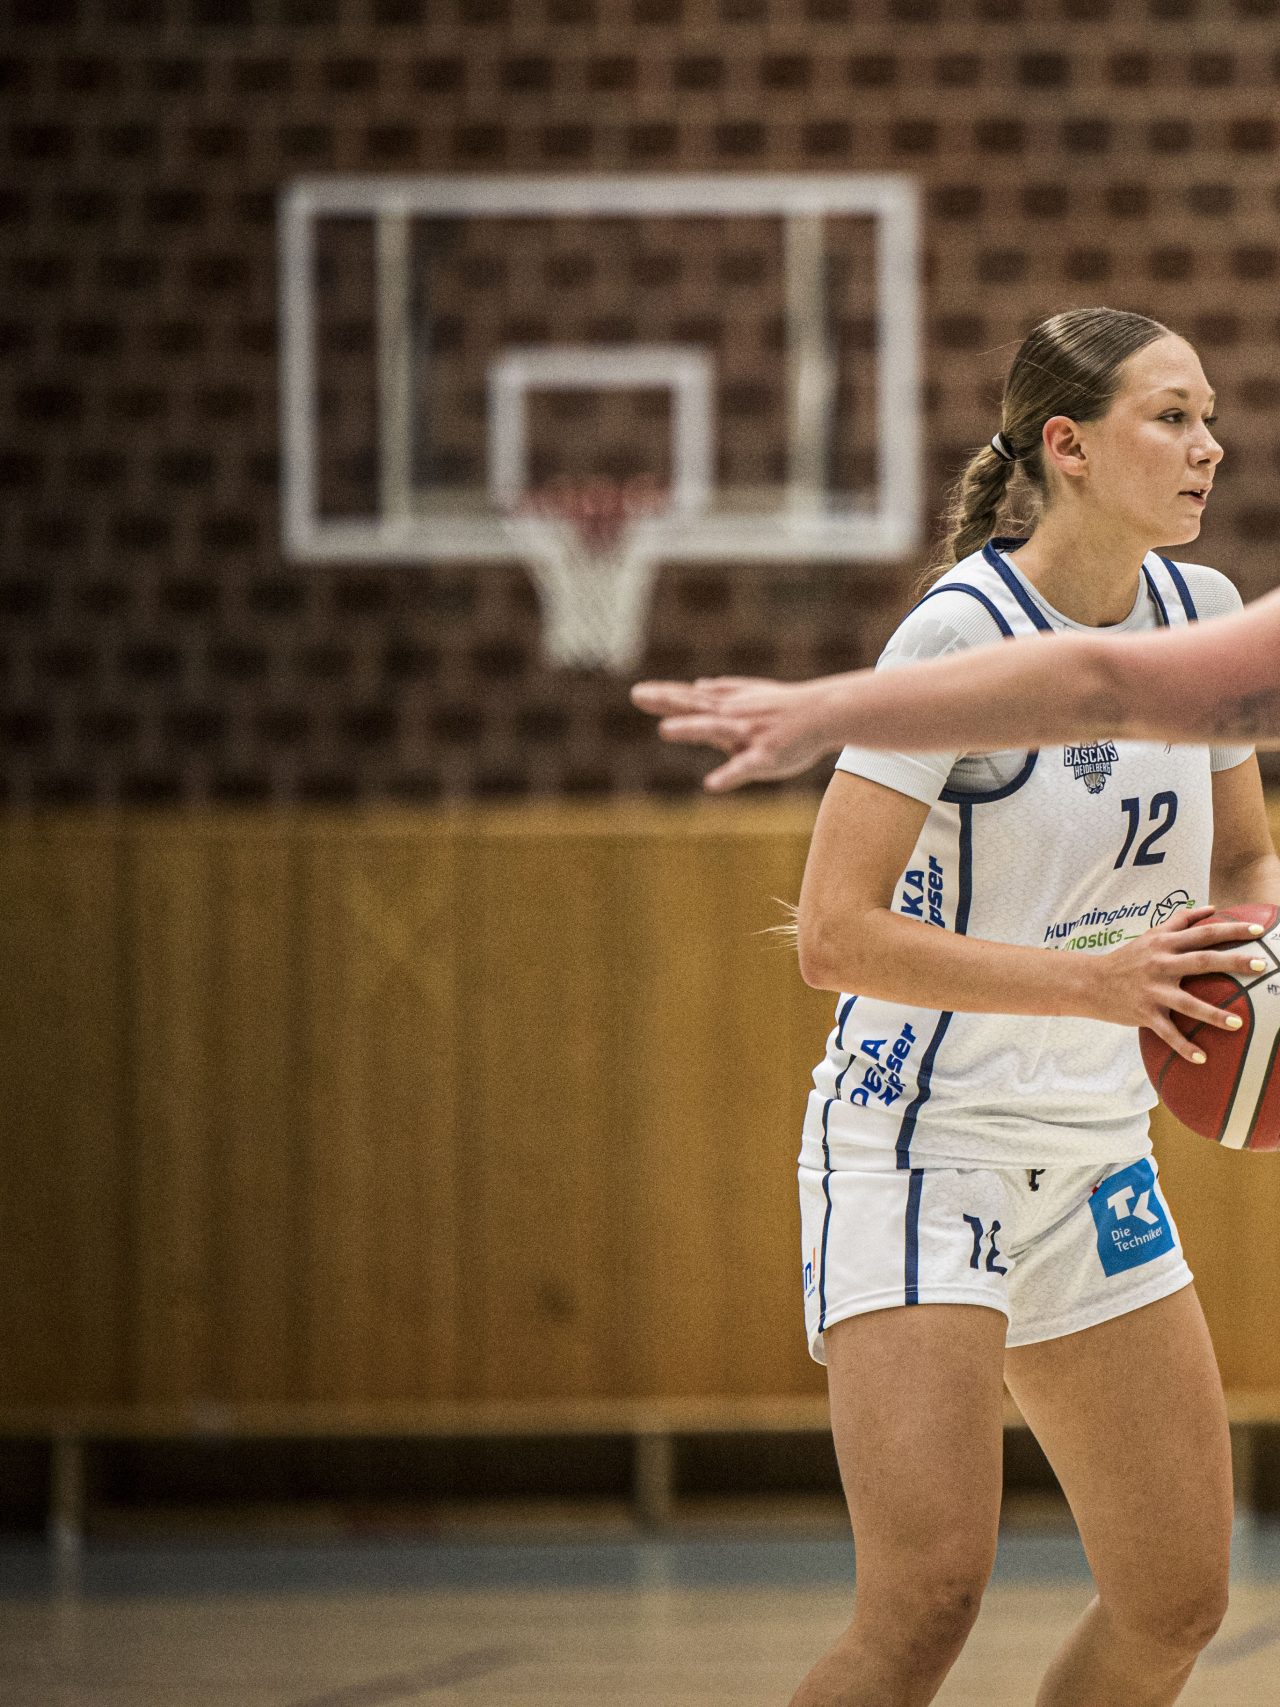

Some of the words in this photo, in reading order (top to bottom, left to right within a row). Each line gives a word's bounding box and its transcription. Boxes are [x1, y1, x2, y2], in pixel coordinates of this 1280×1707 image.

[1064, 741, 1118, 766] BASCATS
[1075, 761, 1111, 778] HEIDELBERG
[1113, 790, 1178, 870] 12
[900, 870, 925, 917] KA
[1106, 1185, 1159, 1225] TK
[1111, 1227, 1131, 1241] Die
[1114, 1226, 1163, 1252] Techniker
